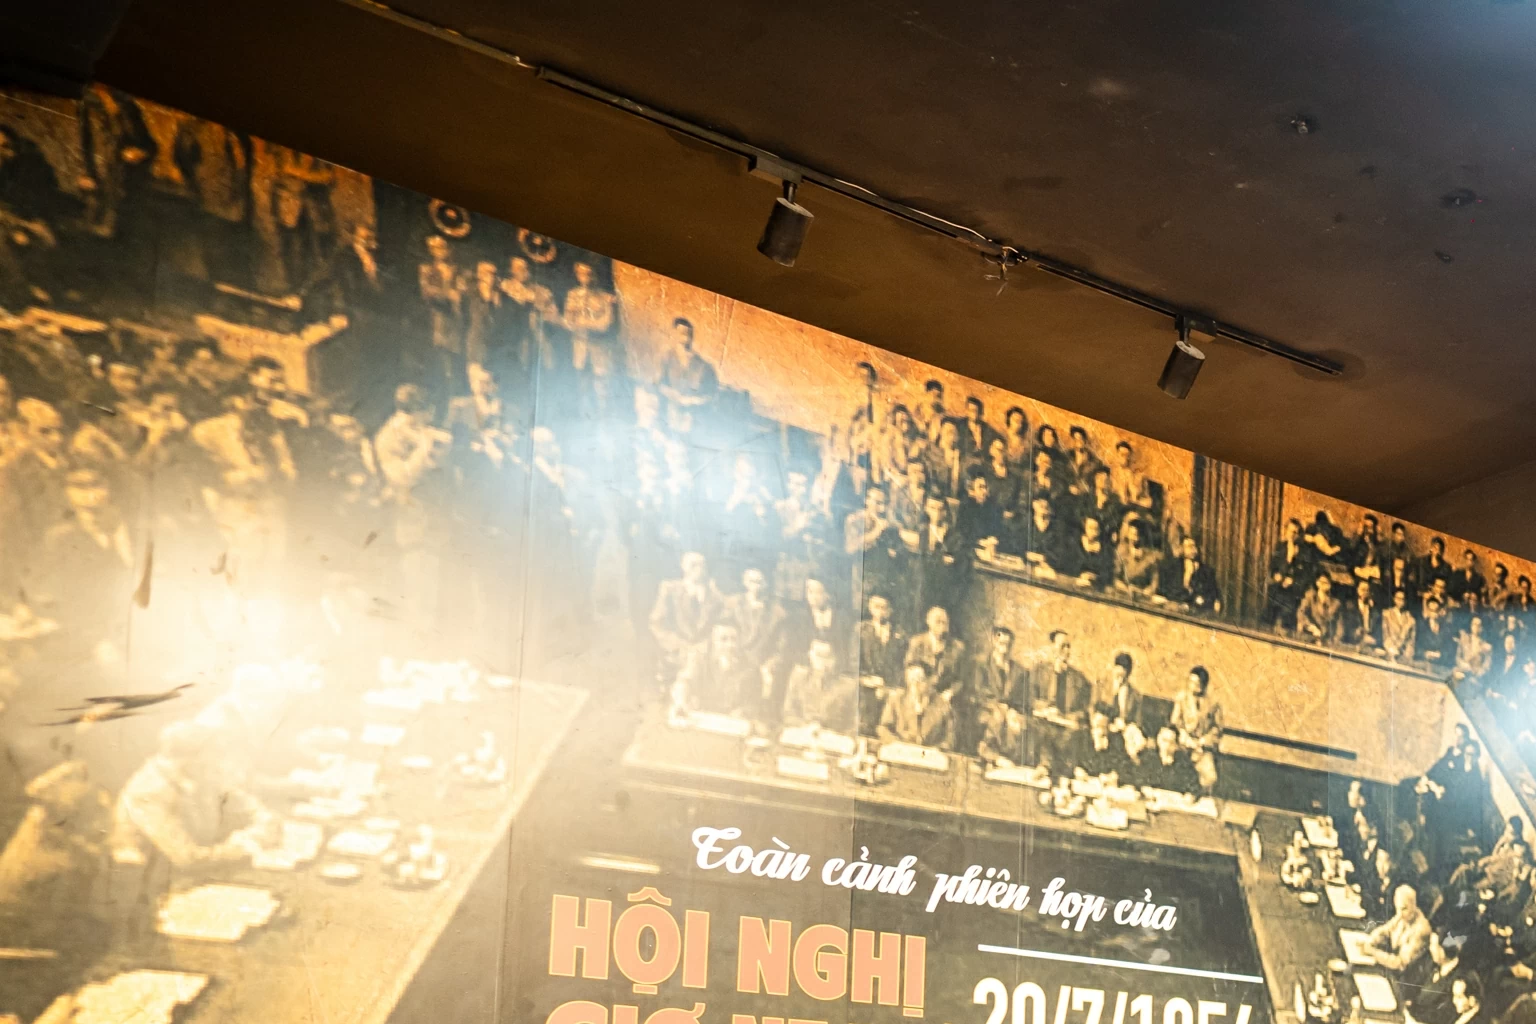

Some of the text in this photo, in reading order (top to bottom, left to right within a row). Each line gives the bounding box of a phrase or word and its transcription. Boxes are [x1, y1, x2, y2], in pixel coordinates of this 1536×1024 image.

[692, 826, 1177, 932] Toàn cảnh phiên họp của
[548, 886, 926, 1018] HỘI NGHỊ
